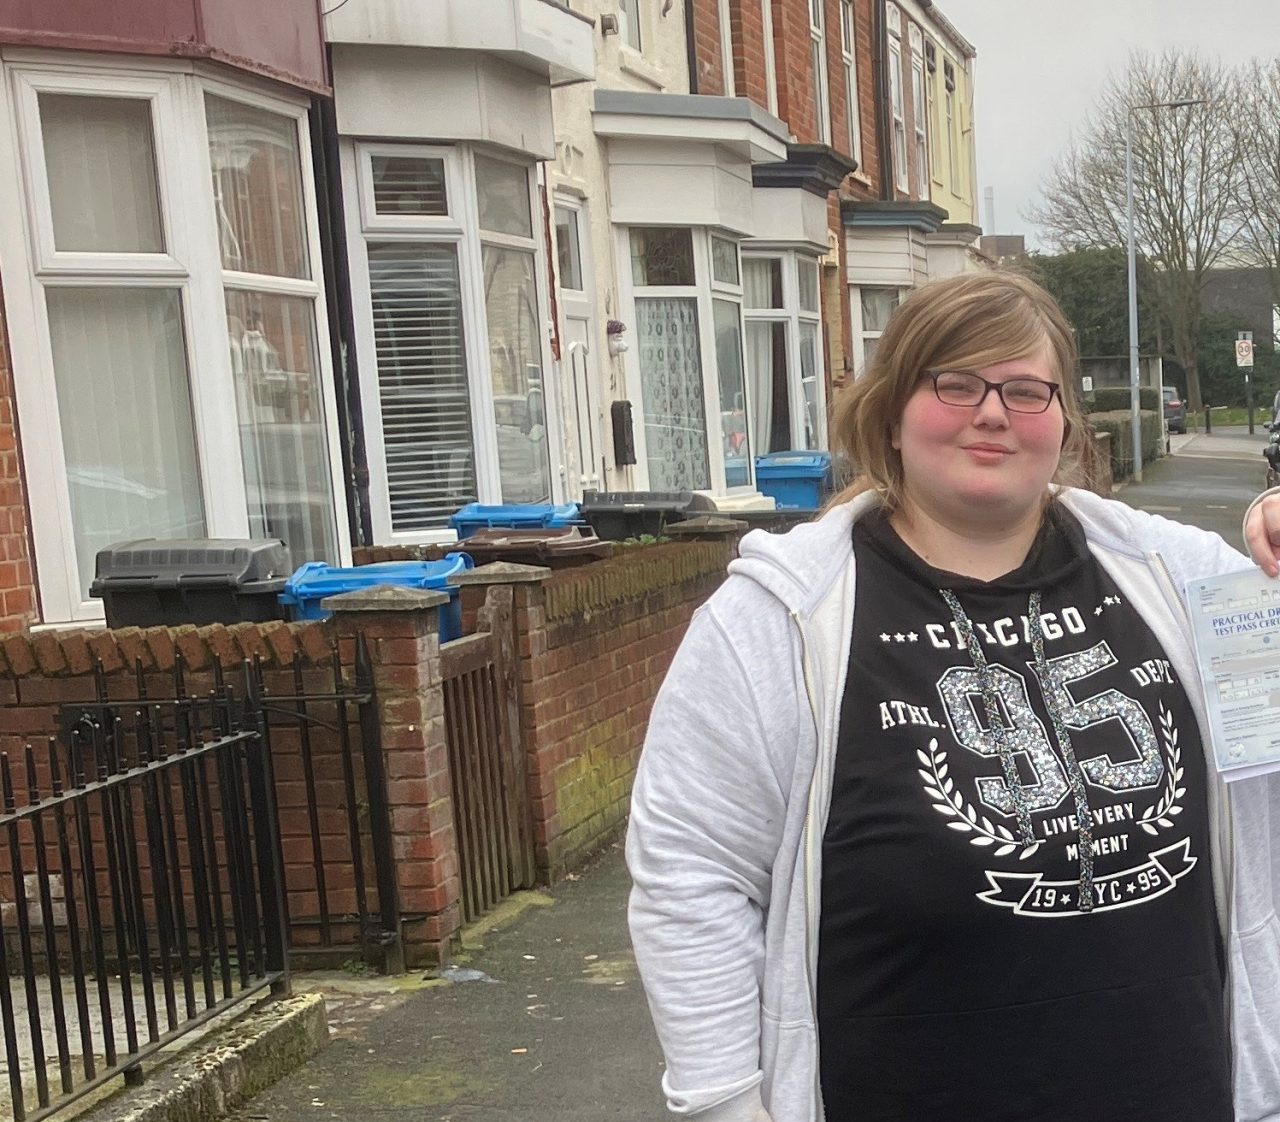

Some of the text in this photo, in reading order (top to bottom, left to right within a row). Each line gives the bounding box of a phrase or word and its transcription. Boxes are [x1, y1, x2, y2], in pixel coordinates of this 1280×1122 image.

[1212, 611, 1265, 628] PRACTICAL
[1214, 626, 1234, 637] TEST
[1236, 623, 1258, 634] PASS
[879, 701, 947, 731] ATHL.
[936, 640, 1164, 817] 95
[1042, 814, 1079, 836] LIVE
[1066, 834, 1129, 861] MMENT
[1031, 867, 1162, 908] 19 YC 95
